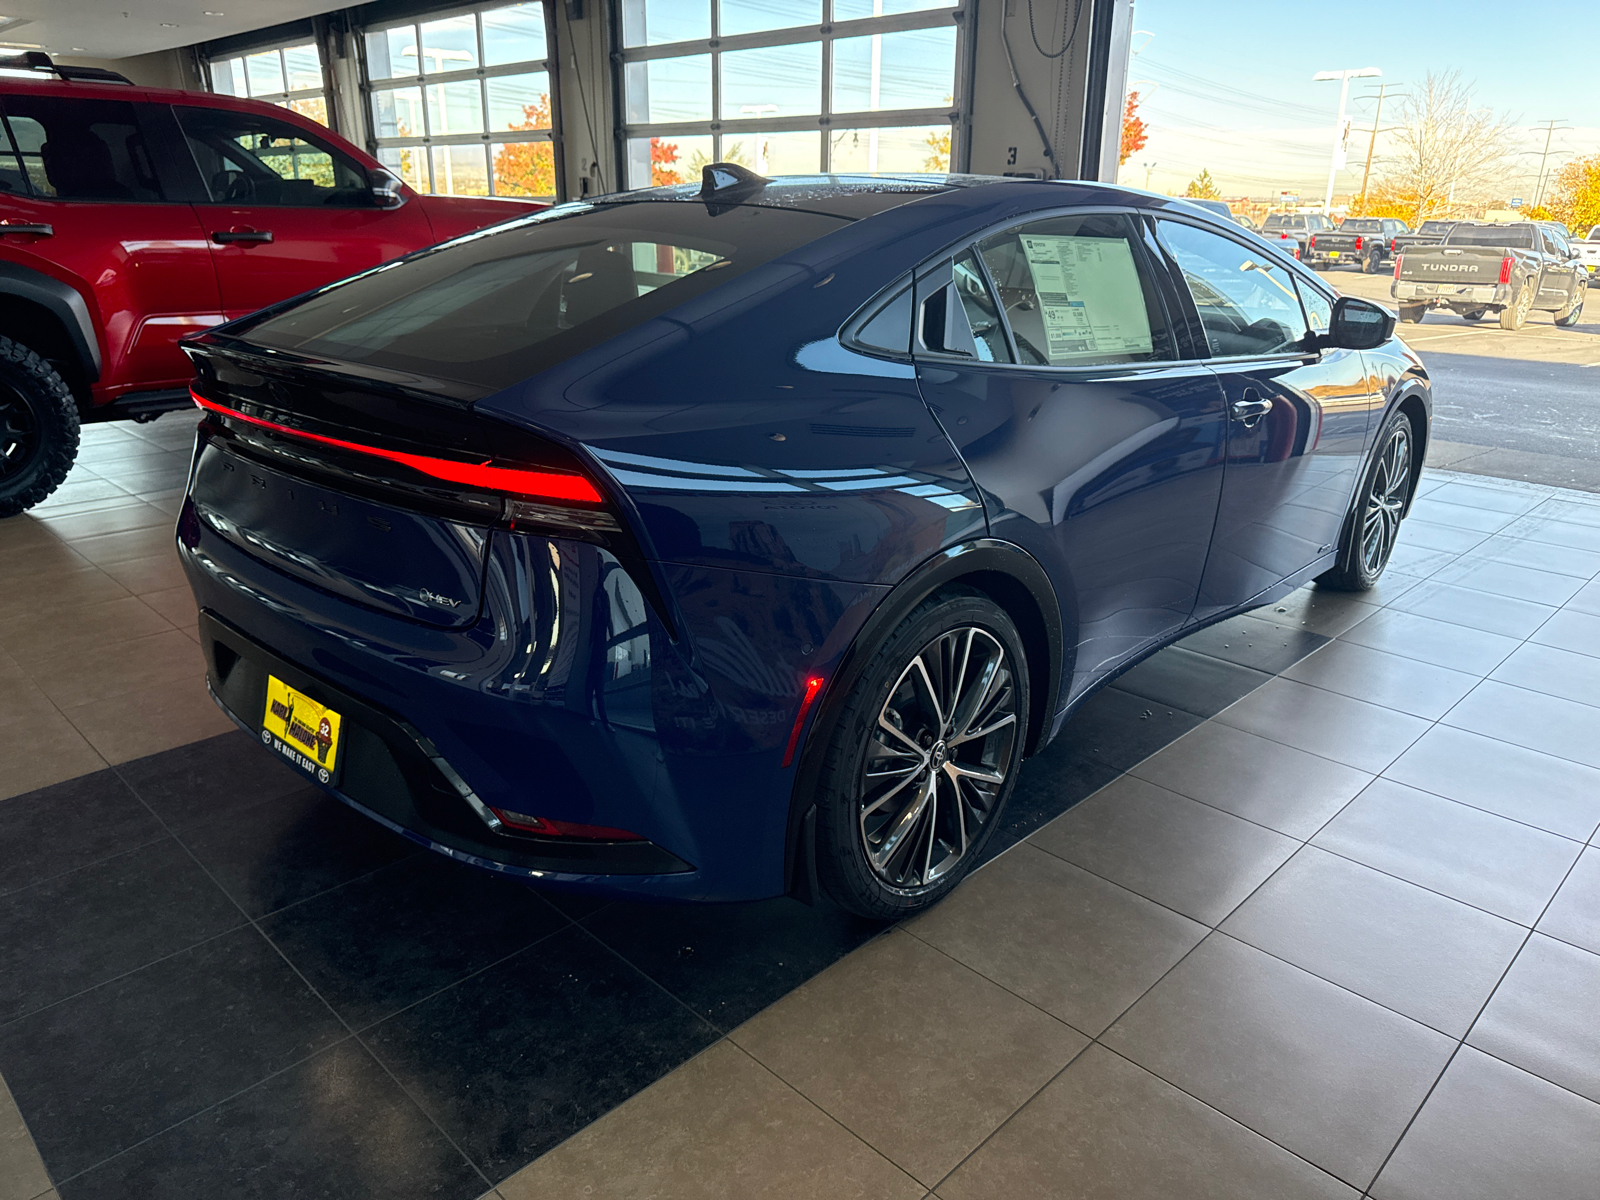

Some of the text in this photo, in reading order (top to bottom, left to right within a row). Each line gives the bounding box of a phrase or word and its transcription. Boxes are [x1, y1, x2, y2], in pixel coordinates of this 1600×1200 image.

[581, 157, 588, 172] 2
[1007, 146, 1018, 165] 3
[1421, 263, 1479, 272] TUNDRA
[1047, 310, 1056, 320] 49
[221, 460, 392, 532] PRIUS
[270, 698, 289, 723] KARL
[288, 720, 317, 751] MALONE
[320, 722, 330, 737] 32
[273, 738, 316, 774] WE MAKE IT EASY
